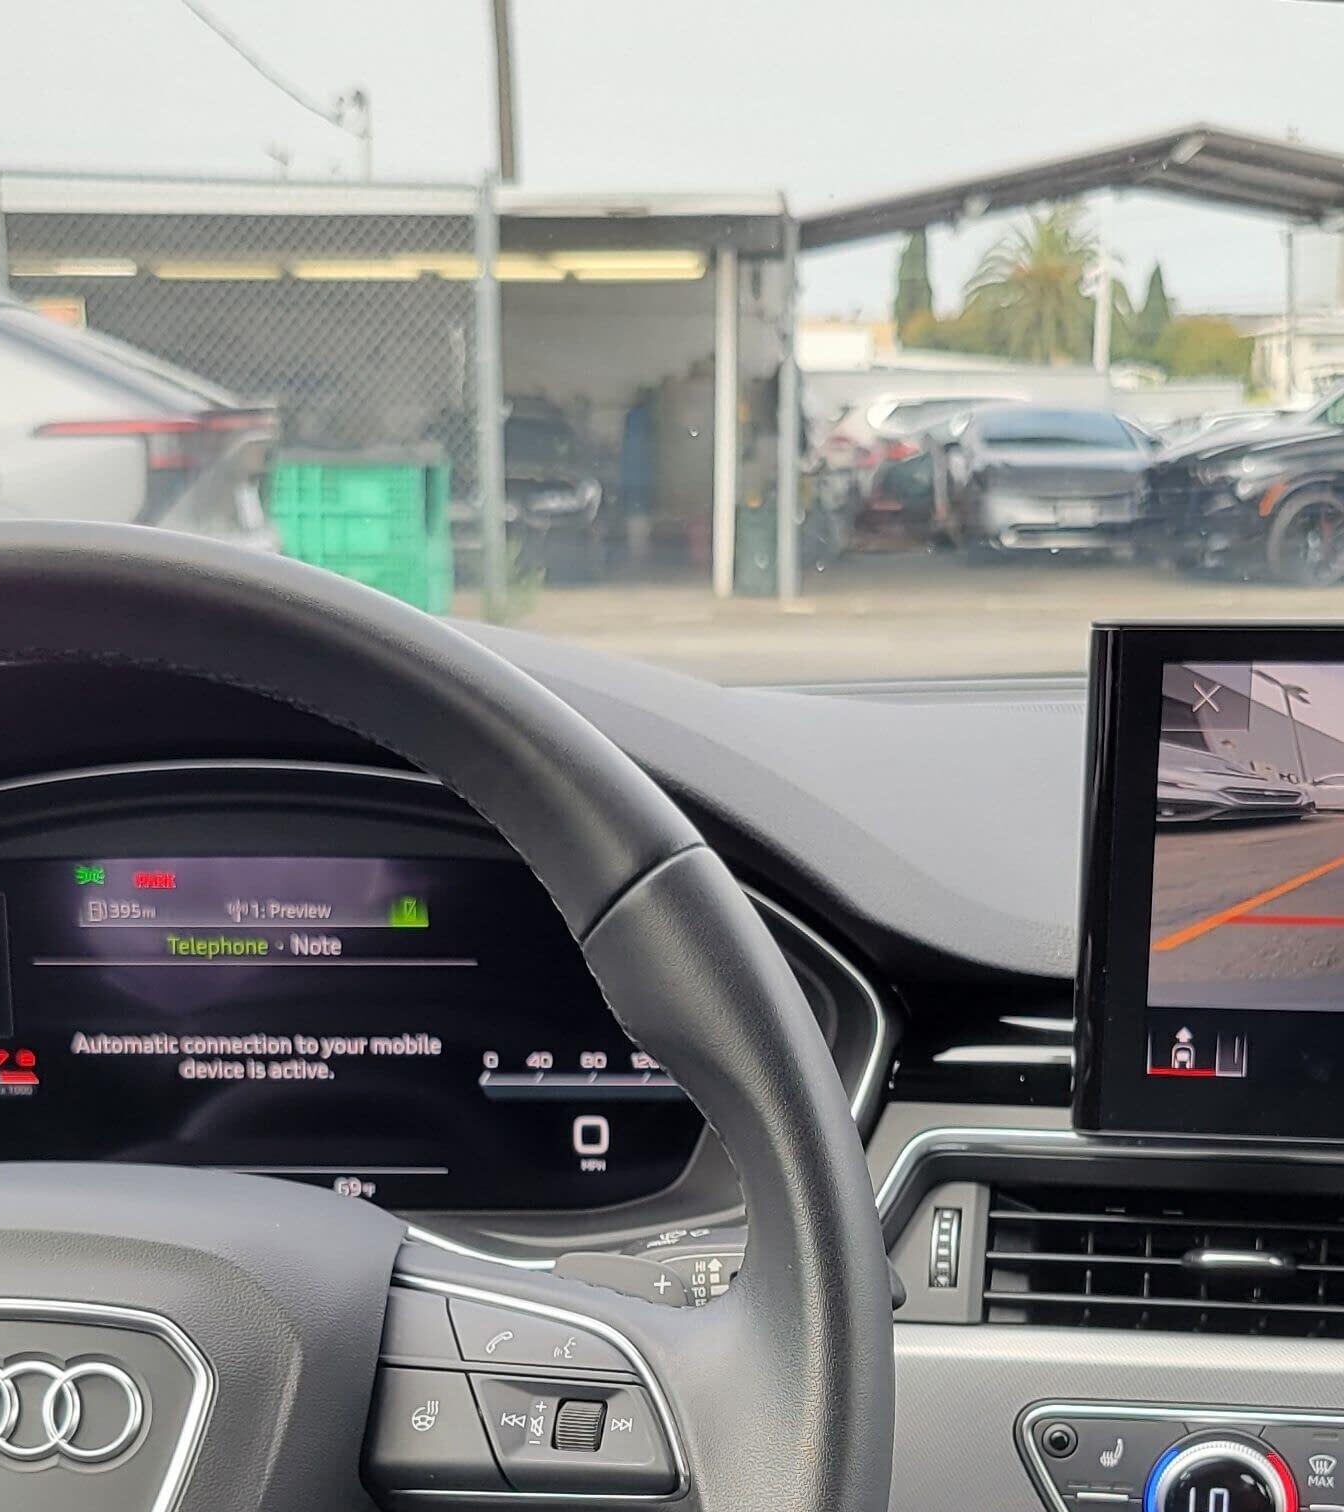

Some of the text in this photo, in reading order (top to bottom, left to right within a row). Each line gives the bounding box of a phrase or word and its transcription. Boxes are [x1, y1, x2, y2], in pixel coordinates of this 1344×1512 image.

[270, 903, 332, 920] Preview
[167, 936, 268, 959] Telephone
[289, 934, 342, 956] Note
[71, 1032, 442, 1059] Automatic connection to your mobile
[178, 1058, 335, 1080] device is active.
[526, 1051, 553, 1069] 40
[573, 1115, 610, 1155] 0
[580, 1159, 607, 1172] MPH
[695, 1260, 706, 1273] HI
[692, 1273, 707, 1285] LO
[1307, 1475, 1335, 1488] MAX
